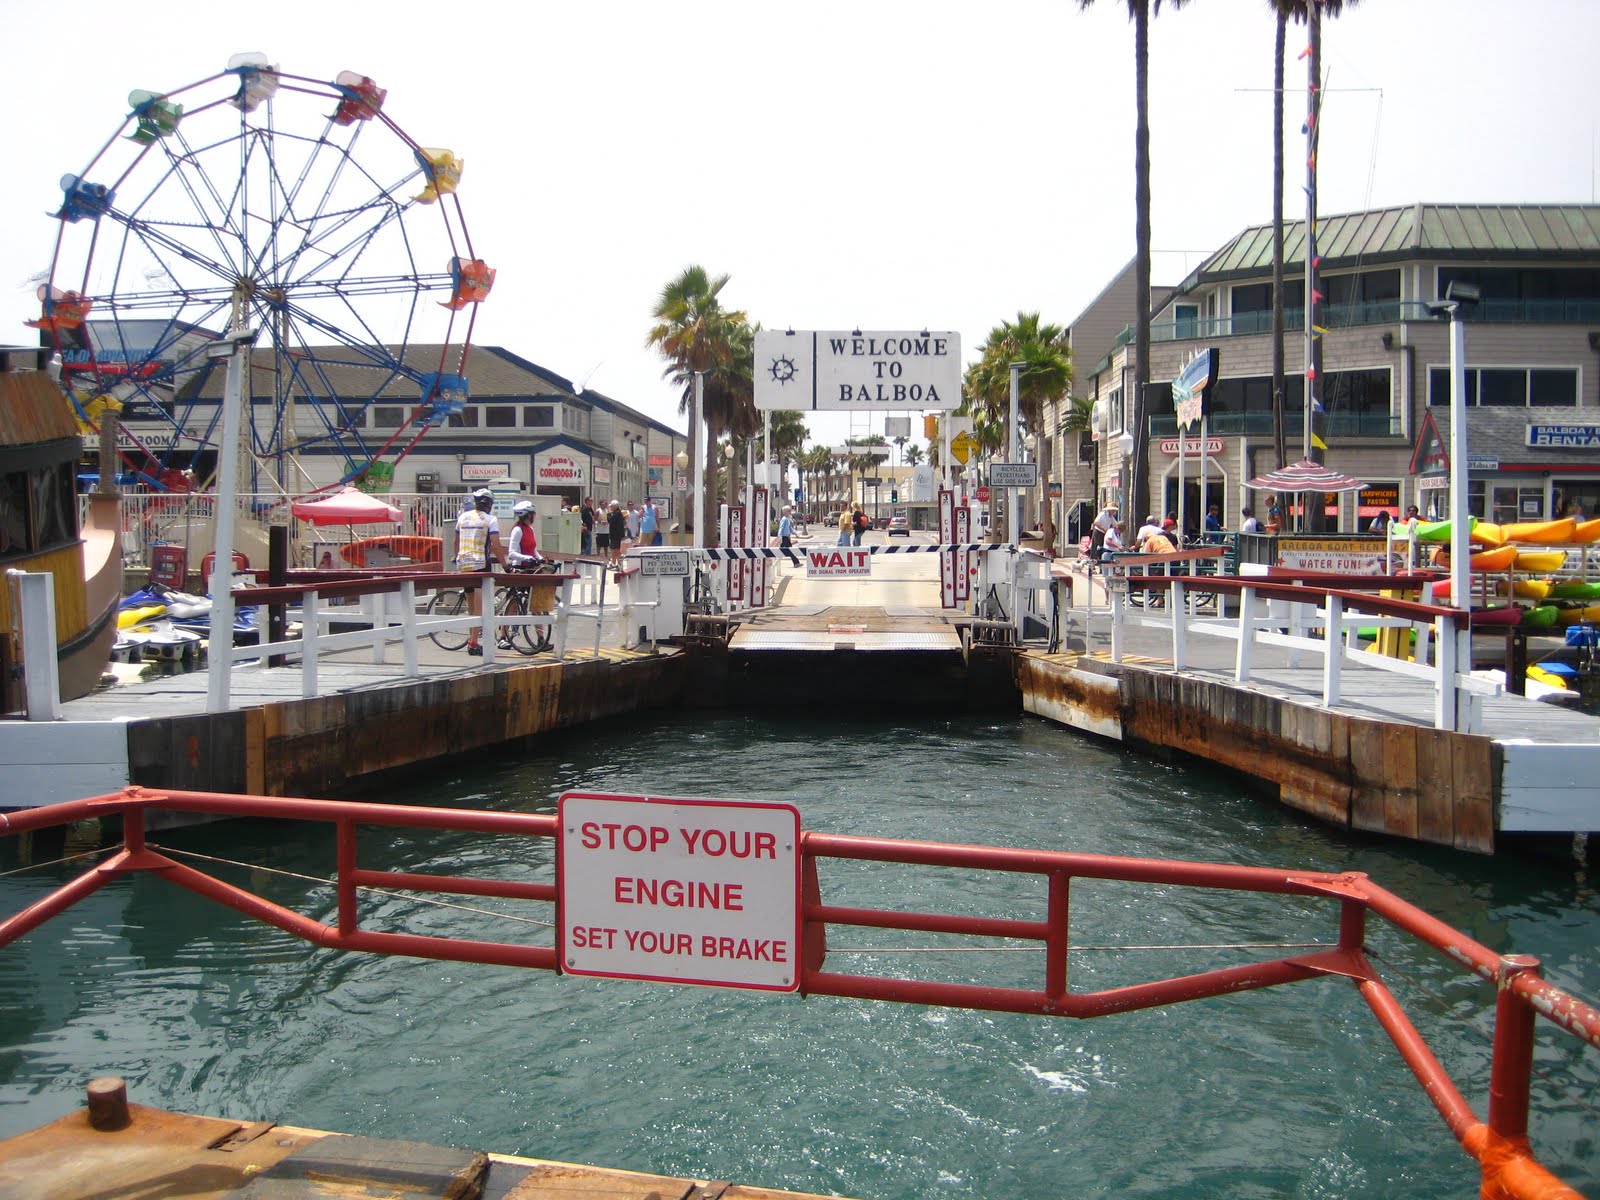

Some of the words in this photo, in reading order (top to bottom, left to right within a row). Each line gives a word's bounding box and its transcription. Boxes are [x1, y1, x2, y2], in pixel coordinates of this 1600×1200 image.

[829, 338, 948, 356] WELCOME
[872, 361, 903, 378] TO
[839, 384, 941, 401] BALBOA
[1537, 426, 1586, 435] BALBOA
[547, 457, 575, 467] Jane's
[539, 468, 574, 478] CORNDOGS
[733, 510, 740, 519] 3
[959, 511, 966, 519] 3
[1281, 542, 1323, 550] BALBOA
[1327, 542, 1355, 551] BOAT
[1360, 542, 1406, 551] RENTLS
[809, 551, 869, 568] WAIT
[1298, 559, 1333, 569] WATER
[1337, 559, 1361, 569] FUN!
[581, 822, 670, 852] STOP
[679, 828, 777, 860] YOUR
[614, 876, 744, 911] ENGINE
[572, 925, 618, 950] SET
[624, 930, 693, 956] YOUR
[701, 935, 787, 963] BRAKE
